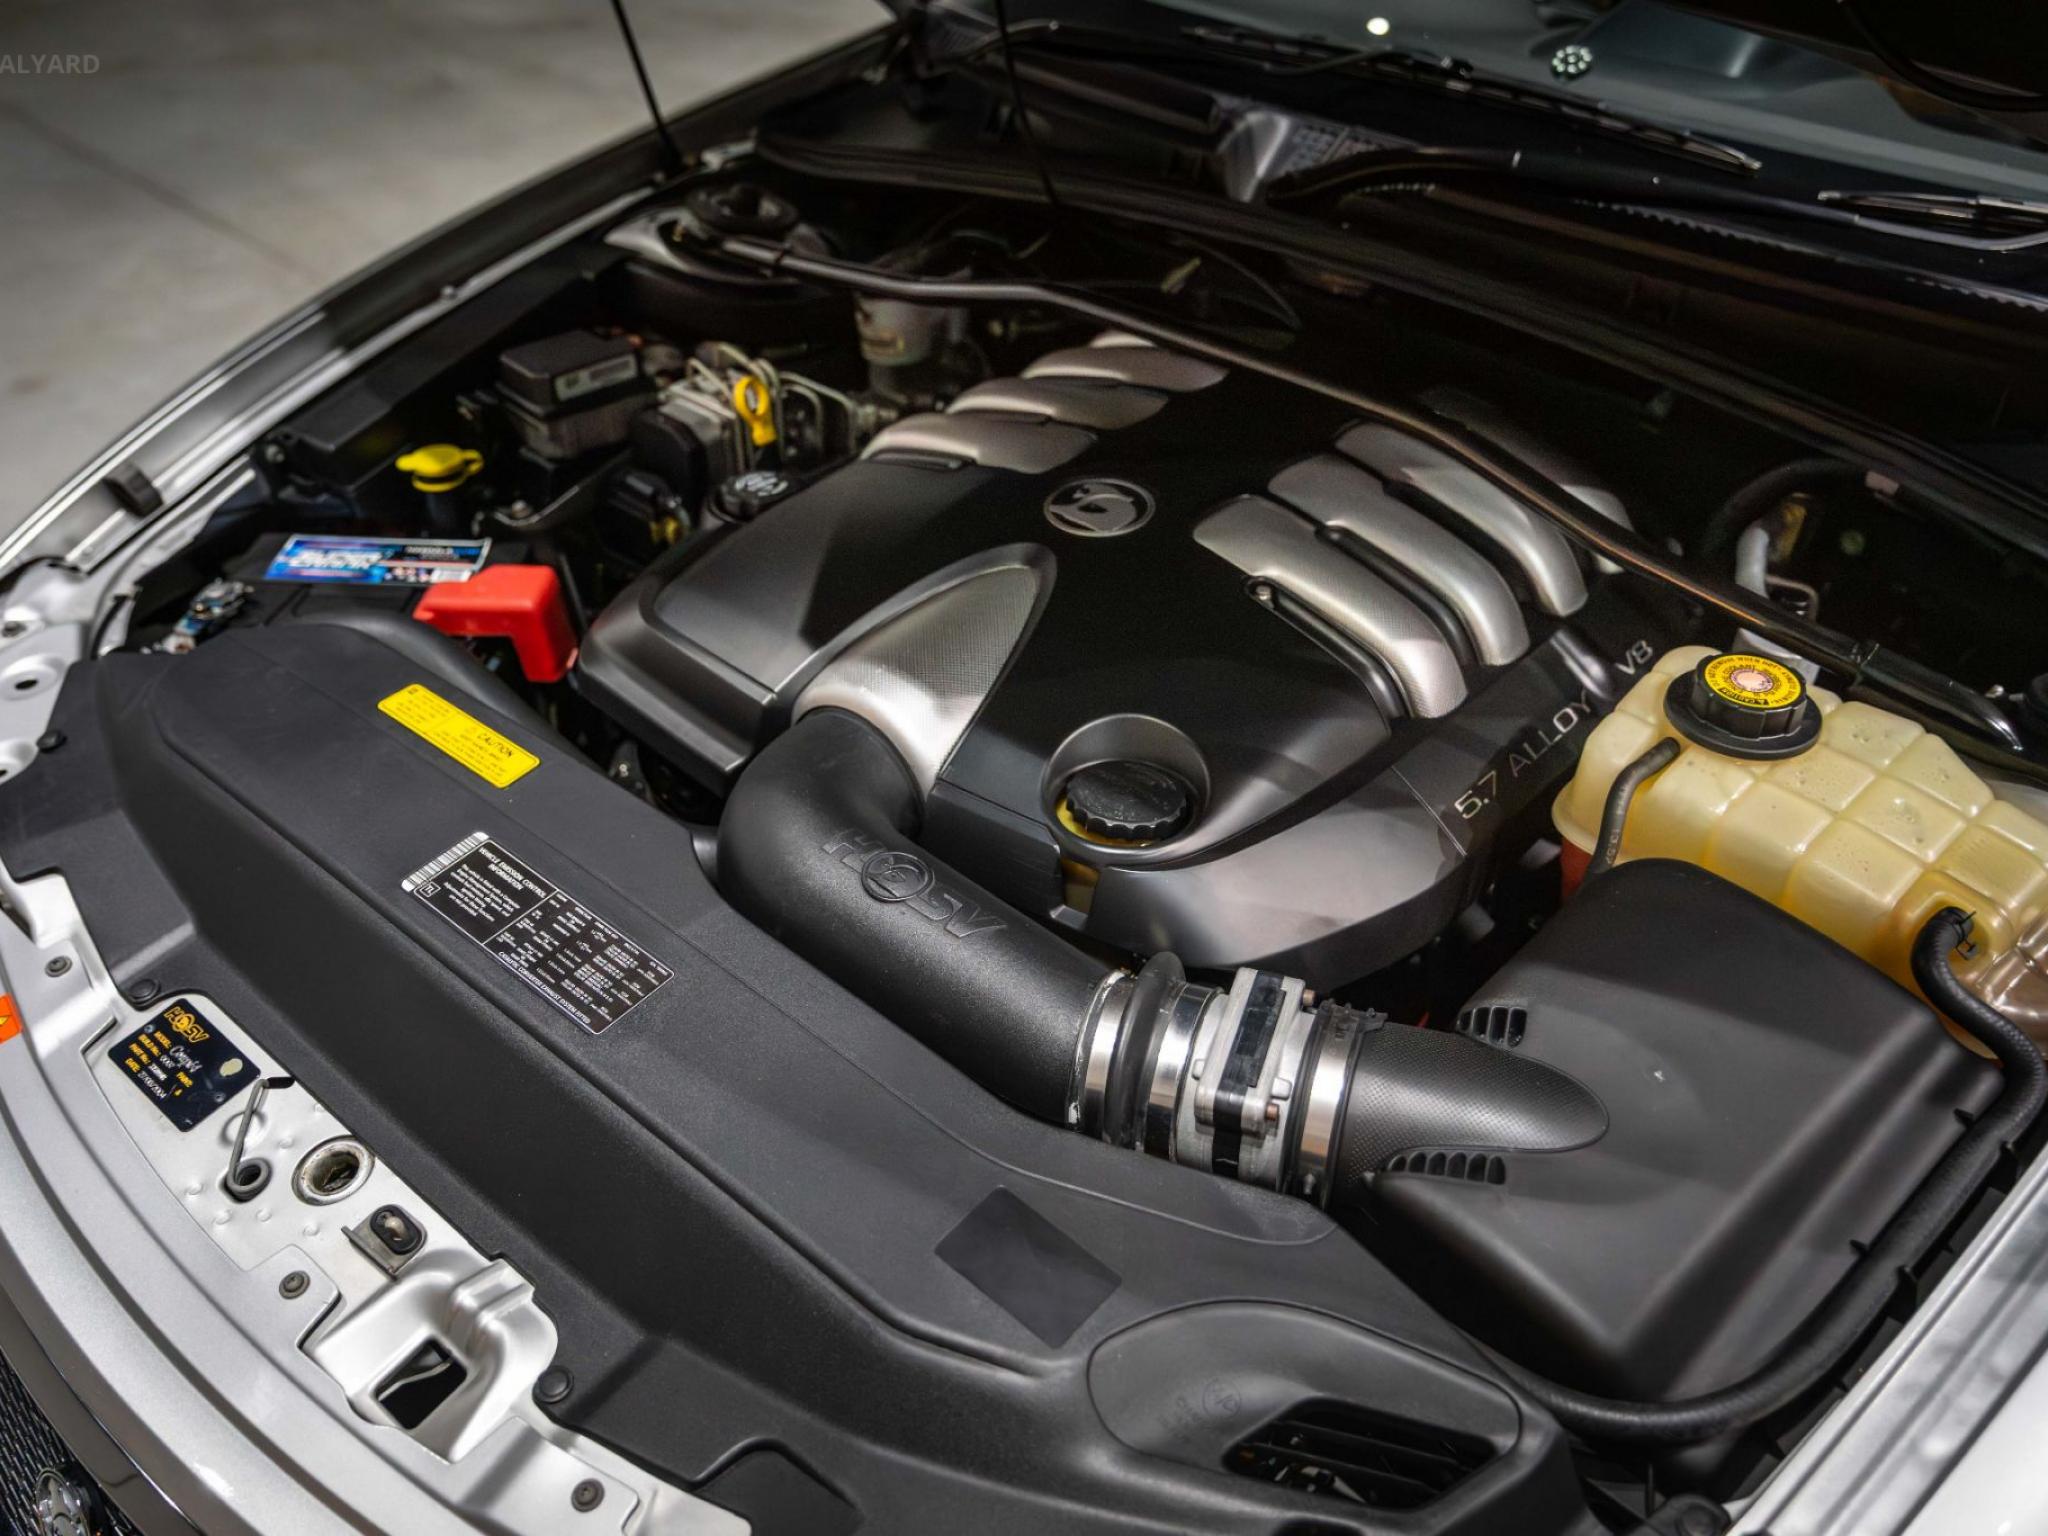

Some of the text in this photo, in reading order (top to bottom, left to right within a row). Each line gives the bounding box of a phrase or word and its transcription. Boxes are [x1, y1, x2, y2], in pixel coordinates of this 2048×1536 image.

[1454, 770, 1498, 820] 5.7
[1509, 691, 1591, 778] ALLOY
[1614, 639, 1654, 676] V8
[476, 732, 514, 758] CAUTION
[520, 878, 548, 899] CONTROL
